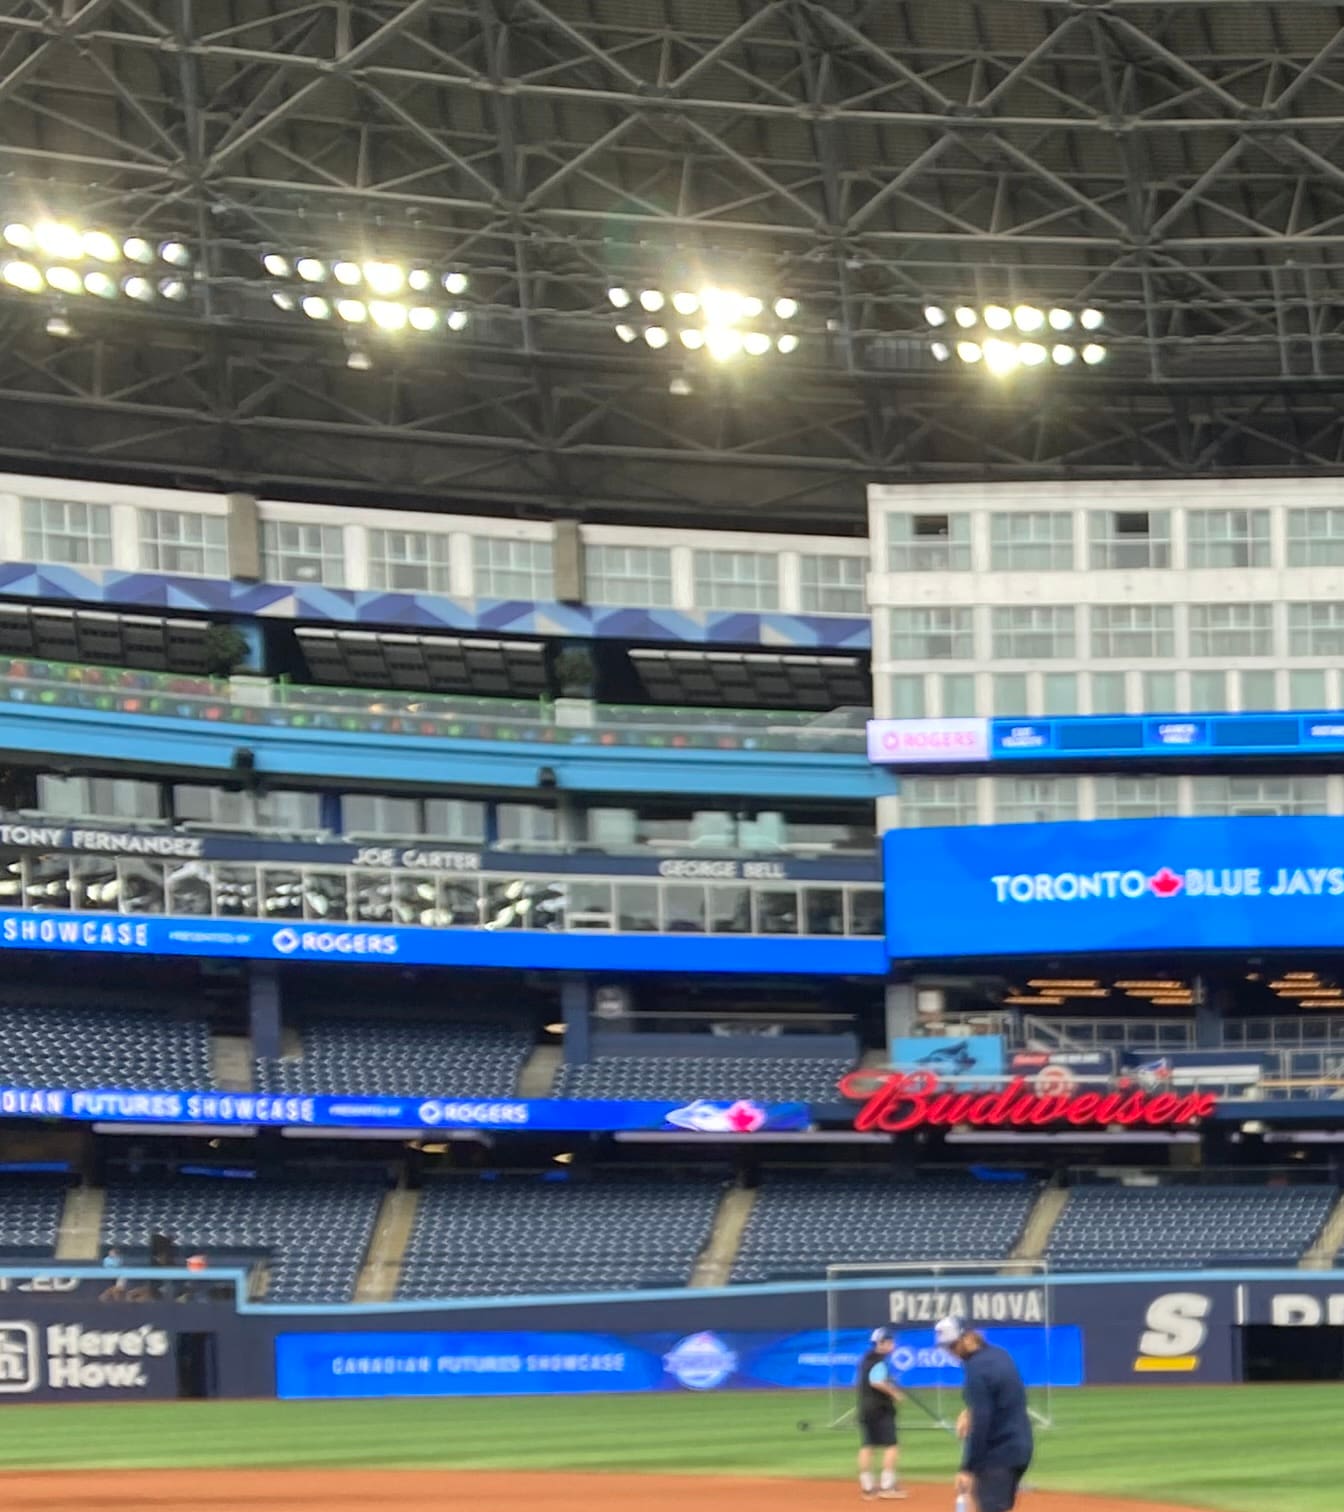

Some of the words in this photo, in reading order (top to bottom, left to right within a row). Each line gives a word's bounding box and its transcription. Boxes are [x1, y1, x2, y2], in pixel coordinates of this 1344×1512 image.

[0, 826, 63, 848] TONY
[72, 830, 204, 857] FERNANDEZ
[352, 847, 394, 867] JOE
[402, 850, 481, 870] CARTER
[659, 860, 737, 878] GEORGE
[743, 862, 787, 879] BELL
[992, 870, 1146, 903] TORONTO
[1184, 868, 1260, 897] BLUE
[3, 917, 148, 946] SHOWCASE
[301, 931, 399, 955] ROGERS
[72, 1091, 183, 1118] FUTURES
[186, 1094, 315, 1122] SHOWCASE
[444, 1102, 529, 1124] ROGERS
[838, 1068, 1217, 1133] Budweiser
[889, 1289, 967, 1324] PIZZA
[971, 1288, 1042, 1322] NOVA
[46, 1322, 169, 1357] Here's
[1139, 1292, 1211, 1357] S
[48, 1357, 148, 1388] How.
[332, 1355, 430, 1375] CANADIAN
[527, 1353, 625, 1372] SHOWCASE
